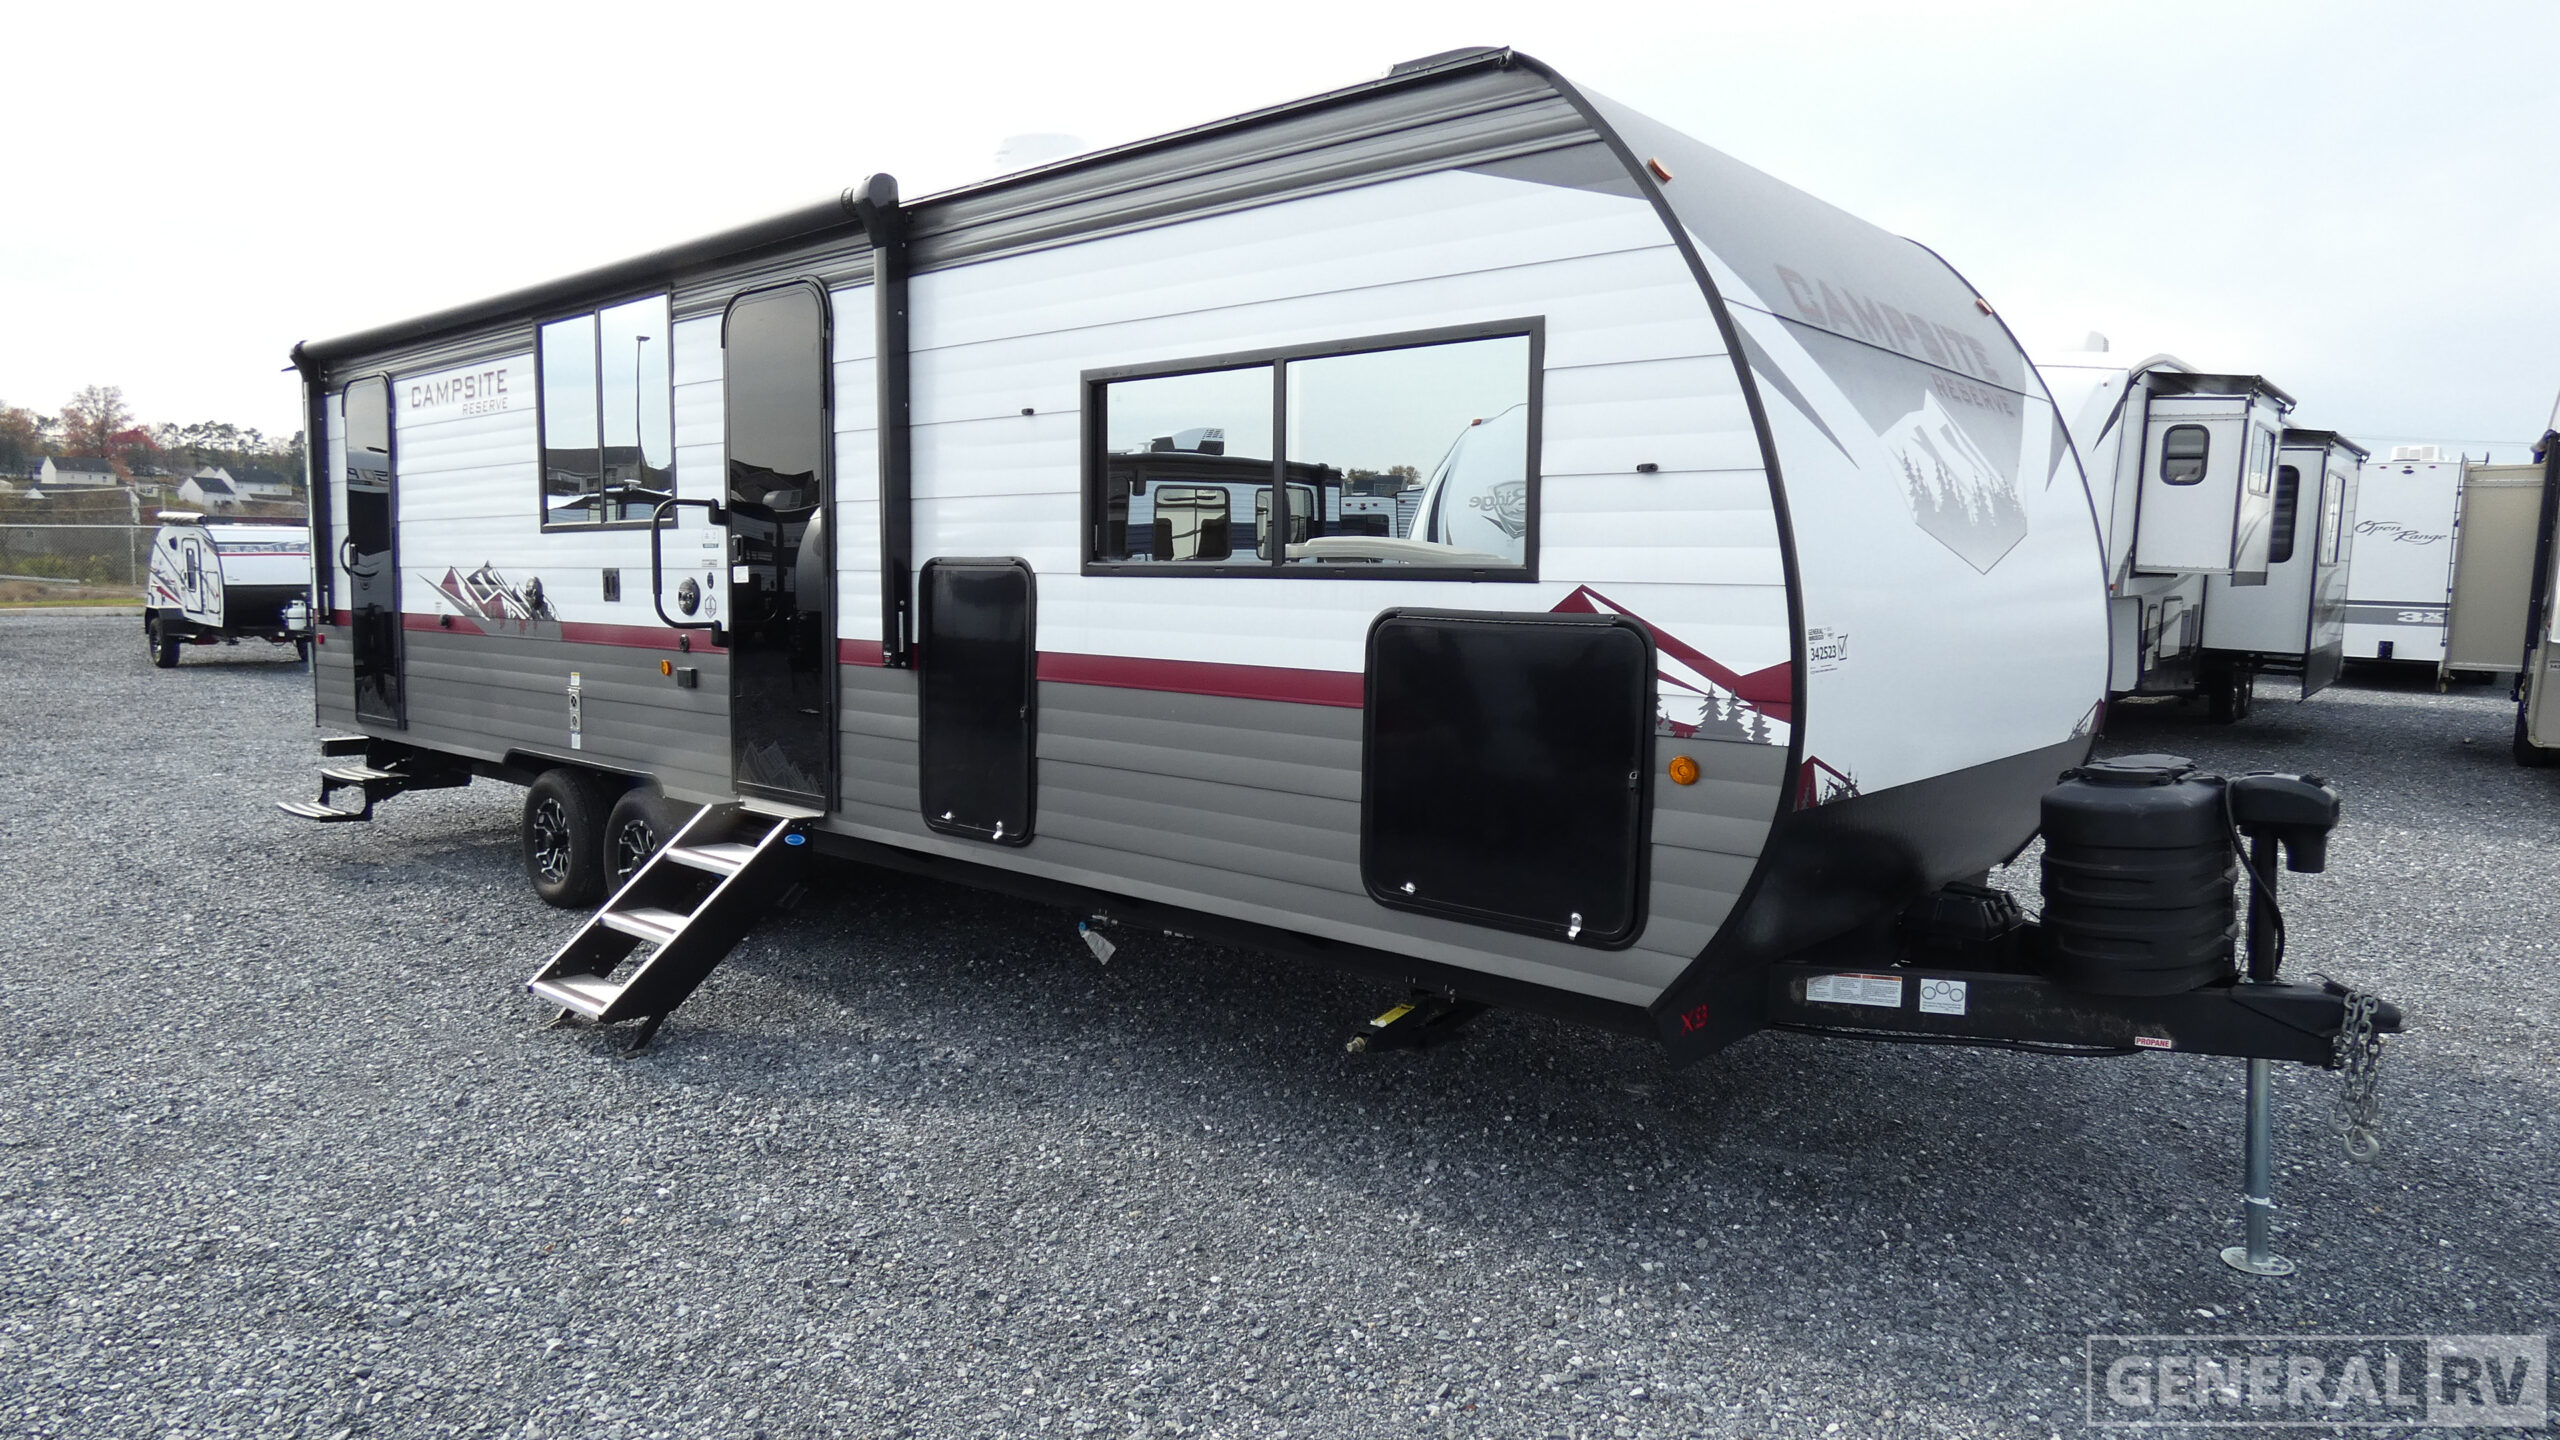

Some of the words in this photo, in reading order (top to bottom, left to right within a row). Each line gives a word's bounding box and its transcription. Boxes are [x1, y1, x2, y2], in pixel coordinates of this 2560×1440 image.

[1774, 263, 2003, 383] CAMPSITE
[411, 369, 508, 409] CAMPSITE
[1930, 372, 2015, 418] RESERVE
[462, 398, 508, 416] RESERVE
[2354, 520, 2403, 535] Open
[2393, 530, 2447, 546] Range
[1810, 645, 1837, 661] 342523
[2136, 1037, 2170, 1048] PROPANE
